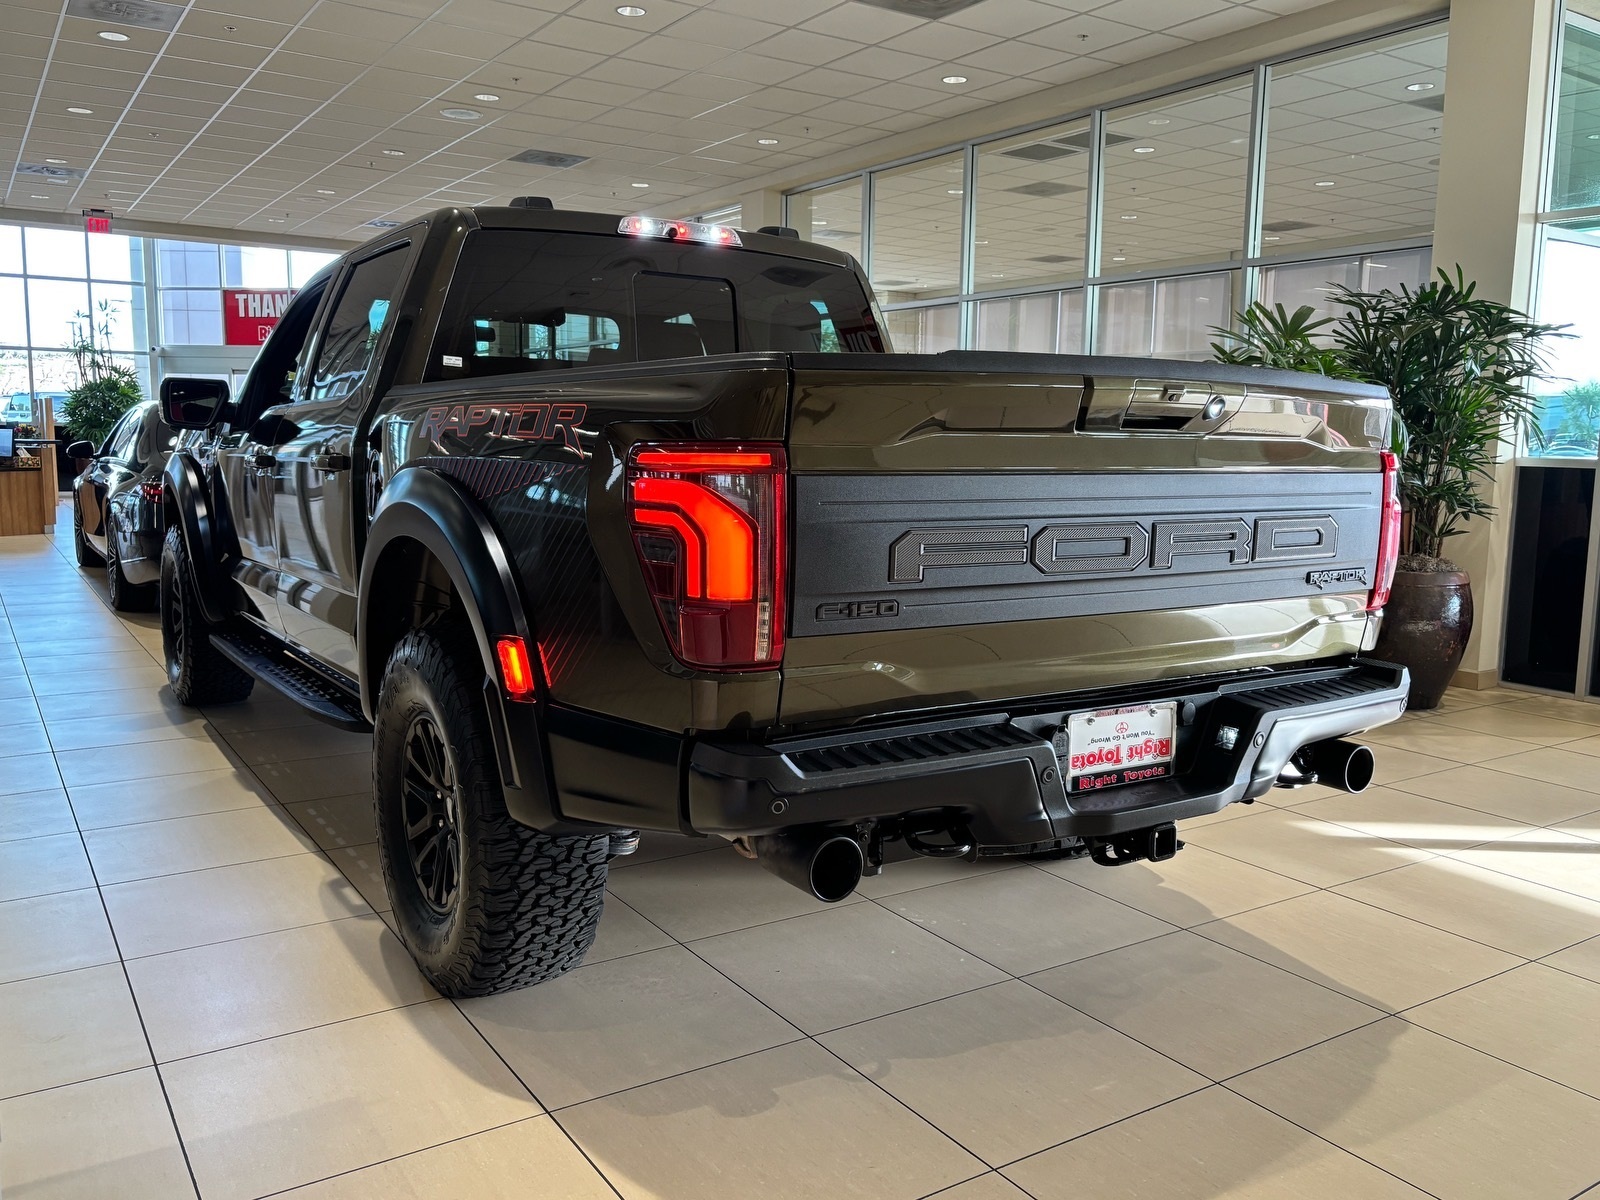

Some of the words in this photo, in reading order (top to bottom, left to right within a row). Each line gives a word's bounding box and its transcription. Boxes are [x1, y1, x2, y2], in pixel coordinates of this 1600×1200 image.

[87, 217, 109, 233] EXIT
[235, 293, 295, 318] THAN
[419, 403, 588, 460] RAPTOR
[889, 514, 1340, 583] FORD
[1306, 567, 1368, 590] RAPTOR
[815, 599, 899, 621] F-150
[1121, 732, 1140, 741] Won't
[1070, 744, 1123, 772] Toyota
[1126, 737, 1172, 761] Right
[1079, 774, 1118, 790] Right
[1123, 766, 1166, 782] Toyota
